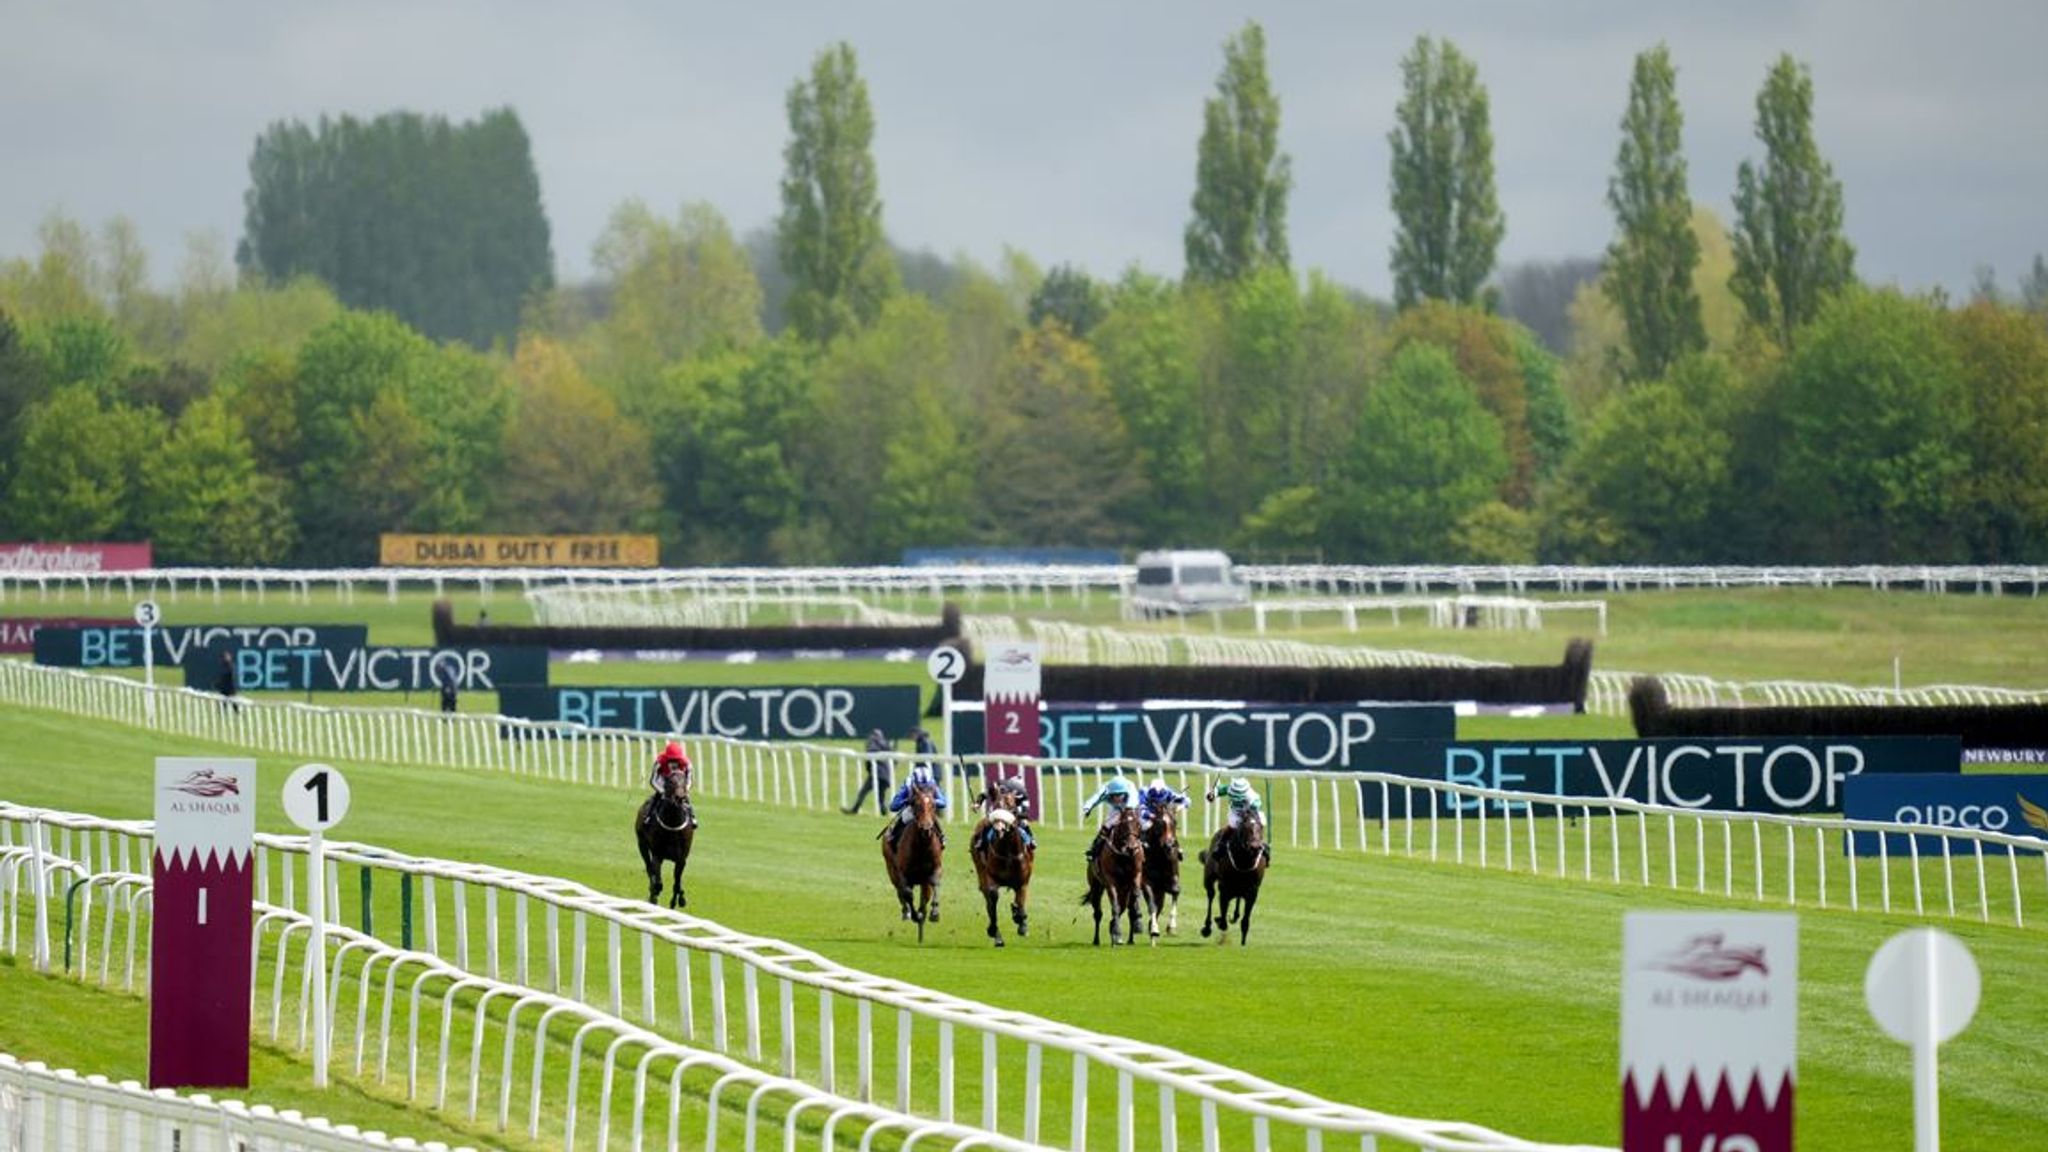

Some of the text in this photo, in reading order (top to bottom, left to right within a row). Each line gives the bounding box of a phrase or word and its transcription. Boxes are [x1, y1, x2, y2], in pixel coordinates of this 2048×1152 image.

[416, 541, 619, 560] DUBAI DUTY FREE
[140, 603, 154, 621] 3
[237, 648, 494, 689] BETVICTOR
[937, 651, 956, 679] 2
[559, 688, 858, 737] BETVICTOR
[1005, 711, 1021, 734] 2
[1965, 749, 2045, 763] NEWBURY
[304, 771, 328, 822] 1
[170, 802, 240, 816] AL SHAQAB
